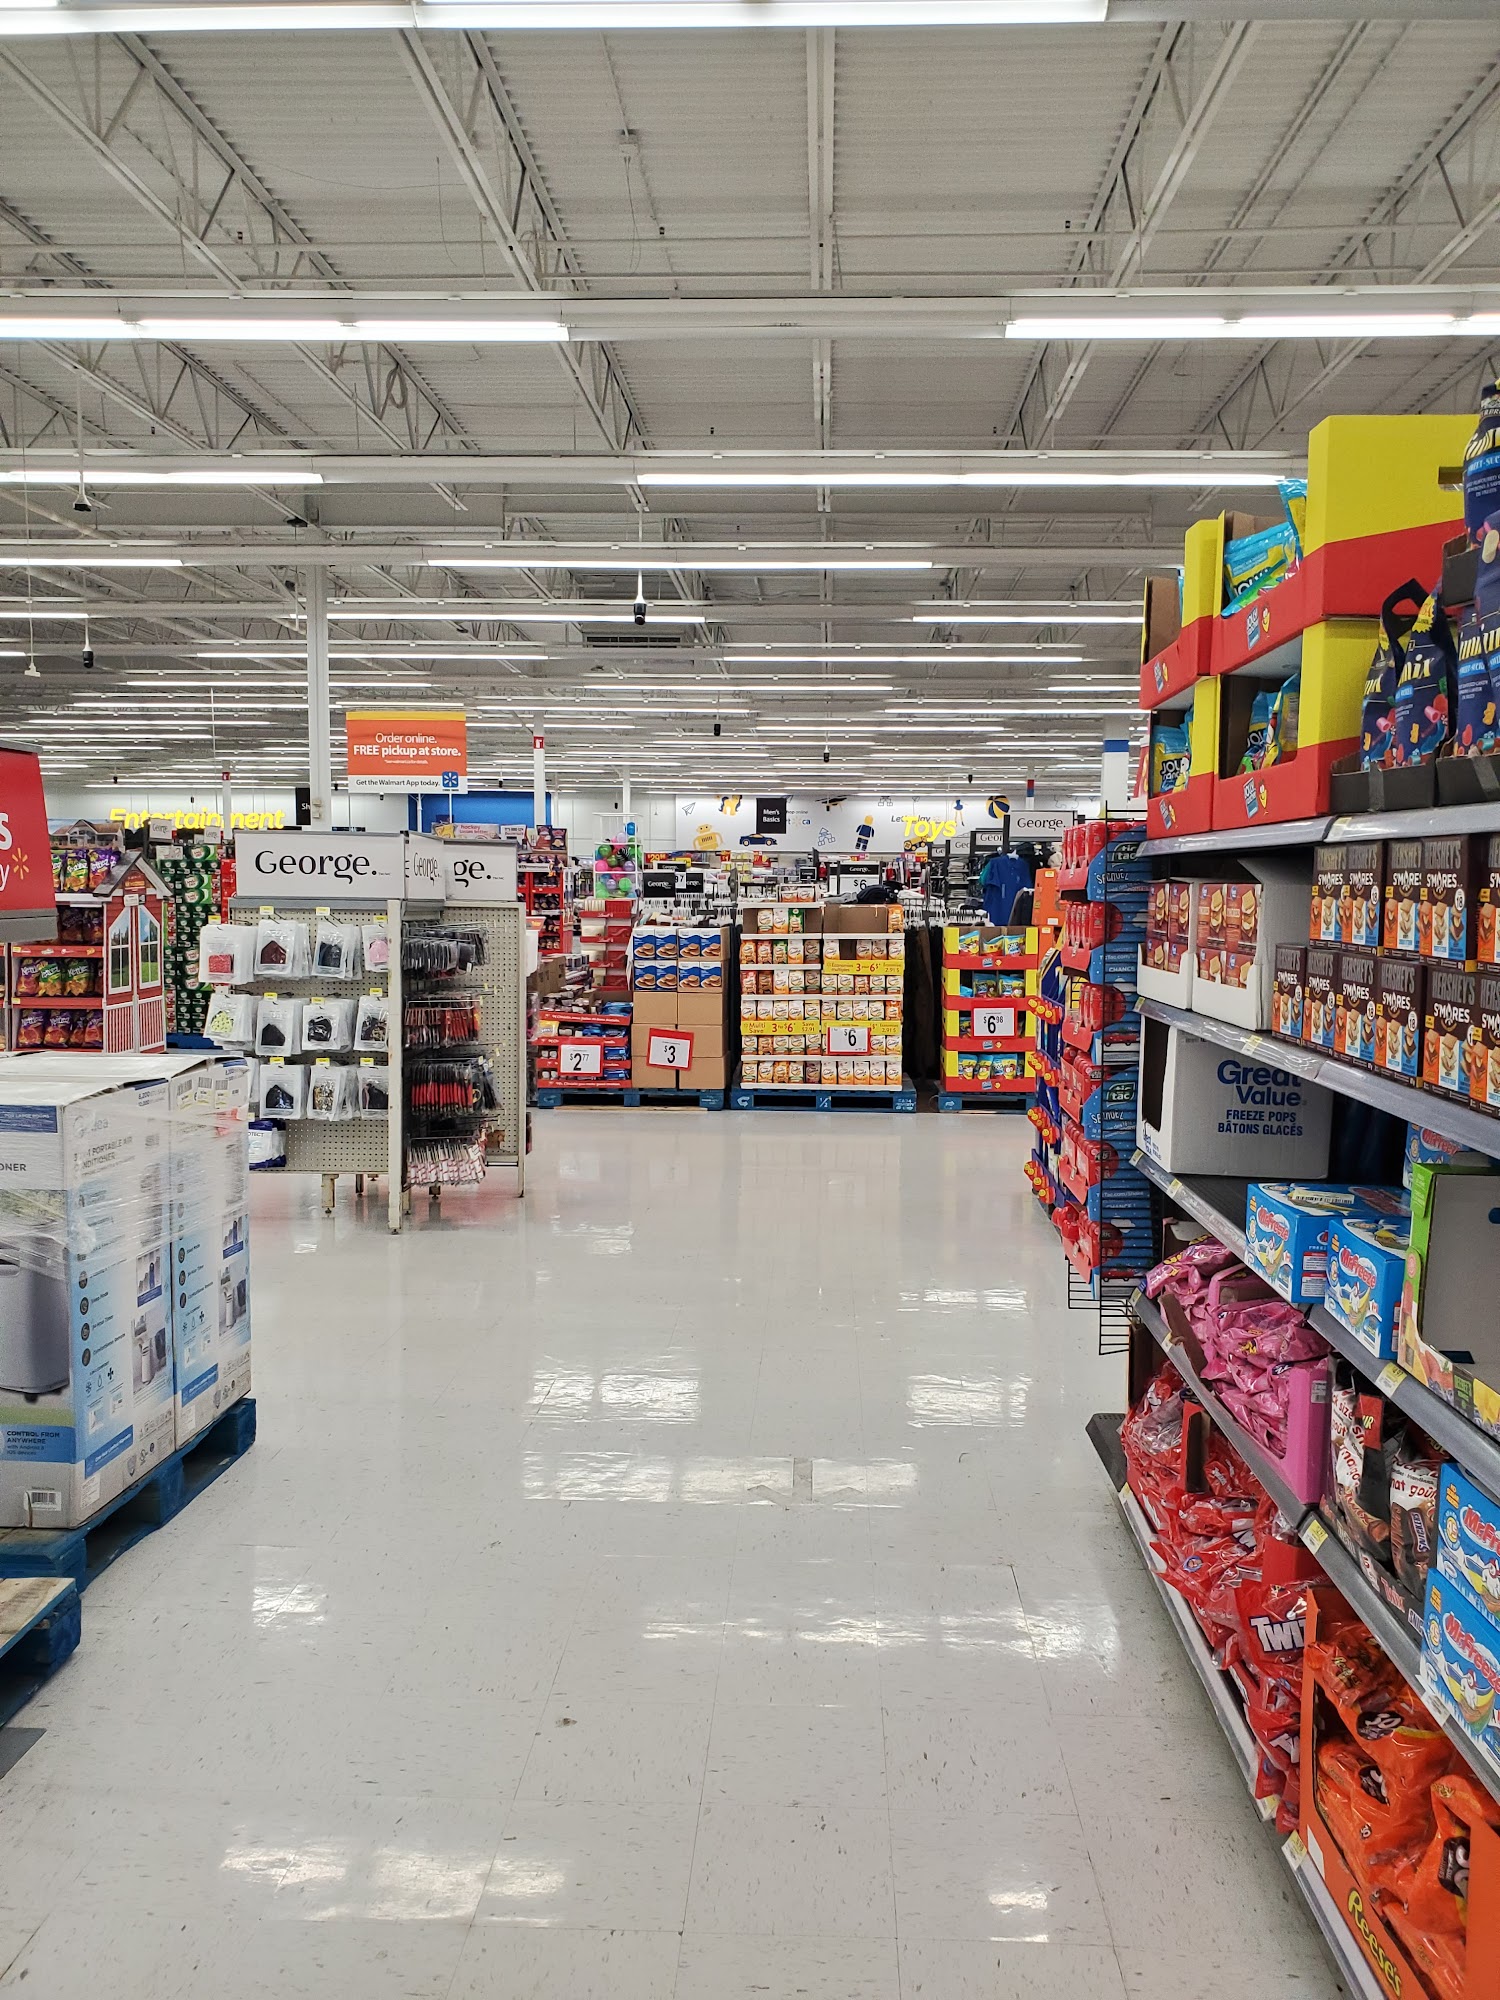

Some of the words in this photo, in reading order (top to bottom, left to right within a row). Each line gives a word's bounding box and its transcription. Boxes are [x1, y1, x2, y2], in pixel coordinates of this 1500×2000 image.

[376, 733, 403, 743] Order
[405, 733, 437, 743] online.
[353, 745, 380, 755] FREE
[382, 745, 416, 758] pickup
[419, 746, 429, 756] at
[431, 747, 461, 756] store.
[903, 816, 957, 842] Toys
[1424, 840, 1461, 870] HERSHEY'S
[1426, 871, 1457, 888] S'MORES
[856, 963, 861, 972] 3
[1381, 962, 1415, 994] HERSHEY'S
[1343, 983, 1370, 1000] S'MORES
[1432, 971, 1475, 1006] HERSHEY'S
[1382, 992, 1411, 1010] S'MORES
[1433, 1003, 1470, 1023] S'MORES
[772, 1023, 777, 1033] 3
[844, 1028, 856, 1047] $6
[664, 1045, 676, 1064] $3
[1217, 1060, 1301, 1087] Great
[1236, 1085, 1301, 1106] Value
[1226, 1109, 1265, 1121] FREEZE
[1268, 1111, 1297, 1122] POPS
[1218, 1121, 1259, 1134] BÂTONS
[1263, 1122, 1303, 1136] GLACÉS
[1410, 1512, 1431, 1552] SNICKERS
[1348, 1888, 1401, 1998] Reese's
